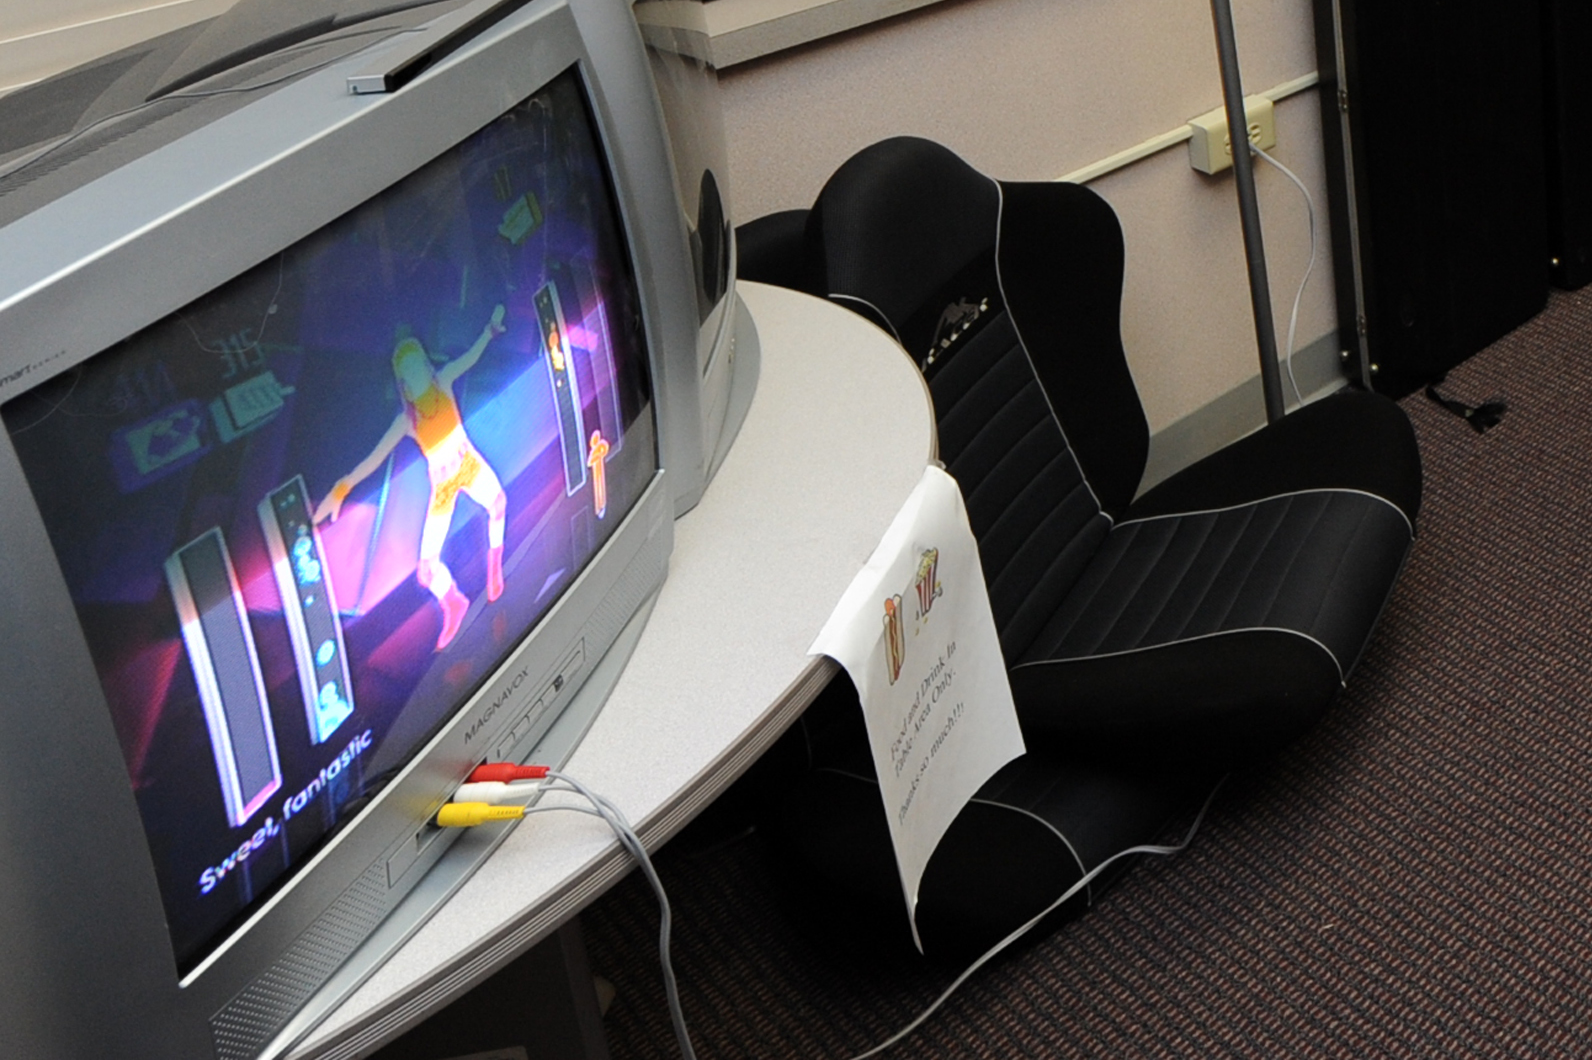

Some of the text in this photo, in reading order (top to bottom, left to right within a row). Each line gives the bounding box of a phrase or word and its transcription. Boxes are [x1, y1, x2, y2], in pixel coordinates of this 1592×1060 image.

[464, 665, 530, 745] MAGNAVOX
[920, 655, 946, 698] Drink
[931, 667, 957, 704] Only.
[198, 728, 373, 895] Sweet, fantastic
